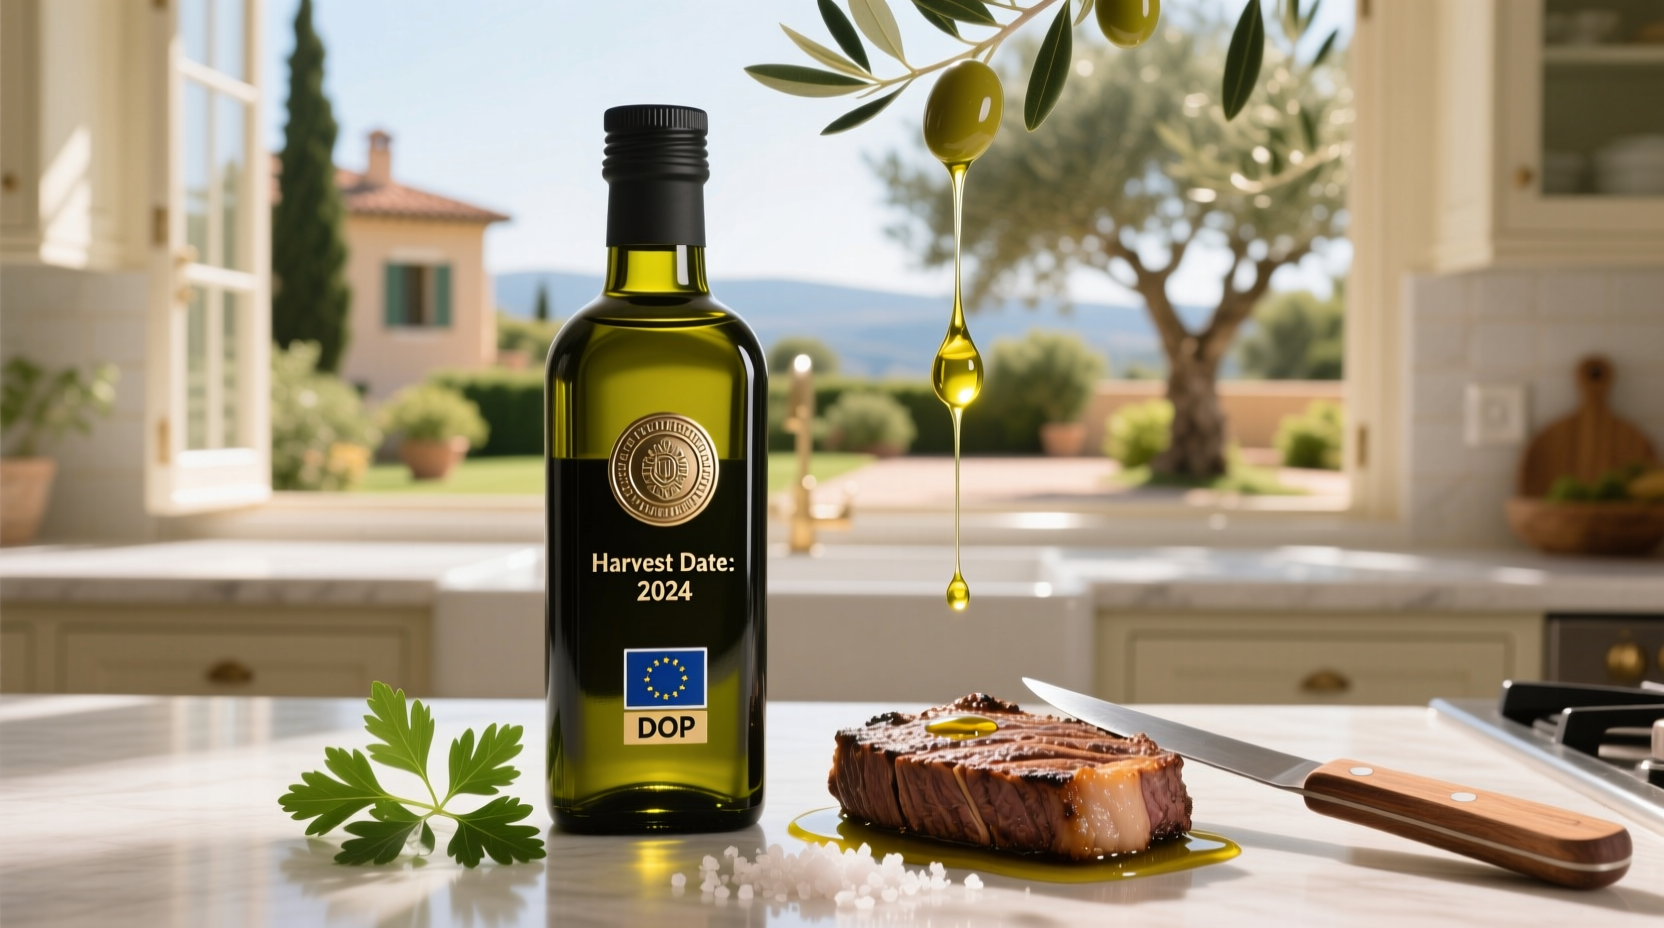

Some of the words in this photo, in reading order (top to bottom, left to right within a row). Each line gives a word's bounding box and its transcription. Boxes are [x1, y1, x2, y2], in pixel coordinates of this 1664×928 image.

[592, 552, 674, 573] Harvest
[680, 552, 735, 573] Date:
[636, 580, 693, 602] 2024
[638, 715, 696, 739] DOP
